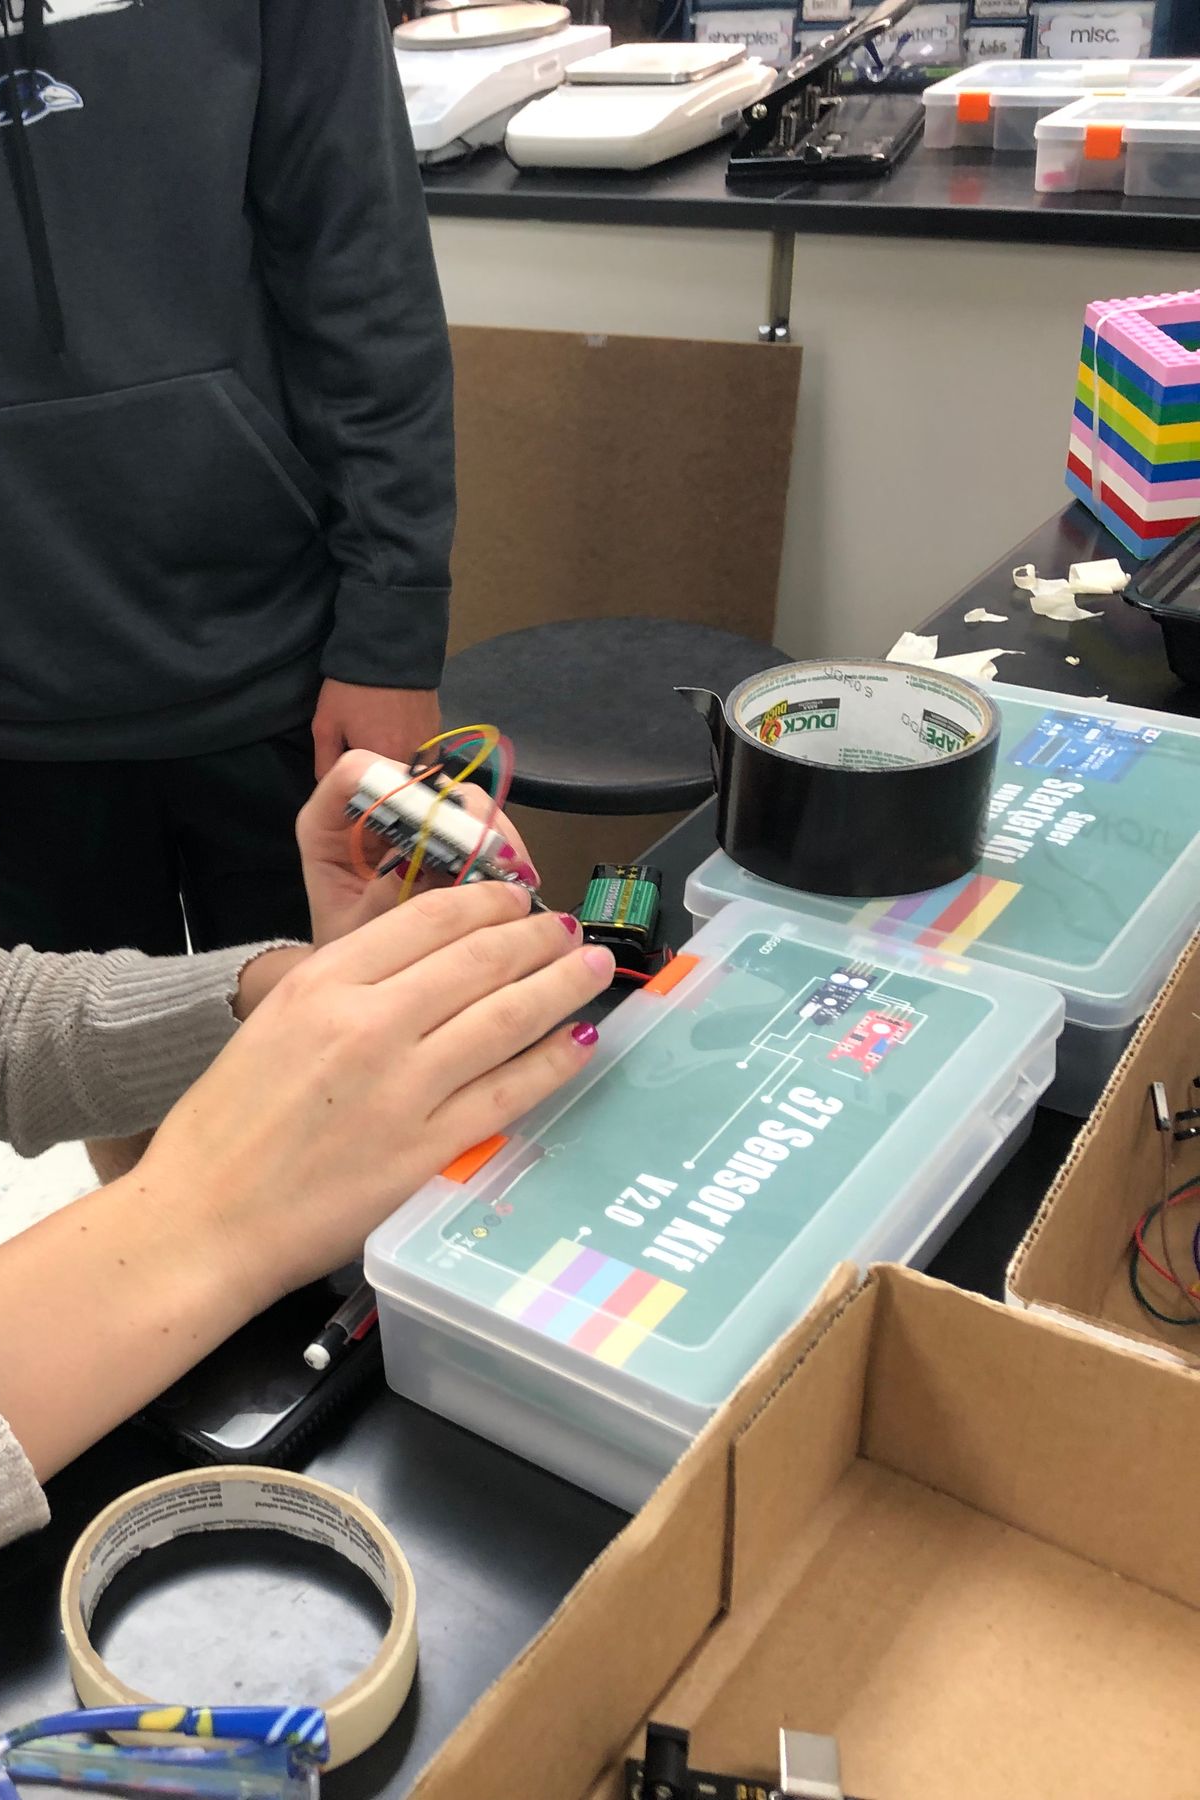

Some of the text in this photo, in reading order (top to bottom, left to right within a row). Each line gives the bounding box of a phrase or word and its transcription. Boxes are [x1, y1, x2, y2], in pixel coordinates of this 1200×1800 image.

[1070, 27, 1120, 44] misc.
[784, 713, 836, 735] DUCK
[981, 778, 1085, 864] Starter Kit
[1045, 811, 1097, 847] Super
[604, 1173, 679, 1228] V 2.0
[641, 1086, 844, 1273] 37 Sensor Kit
